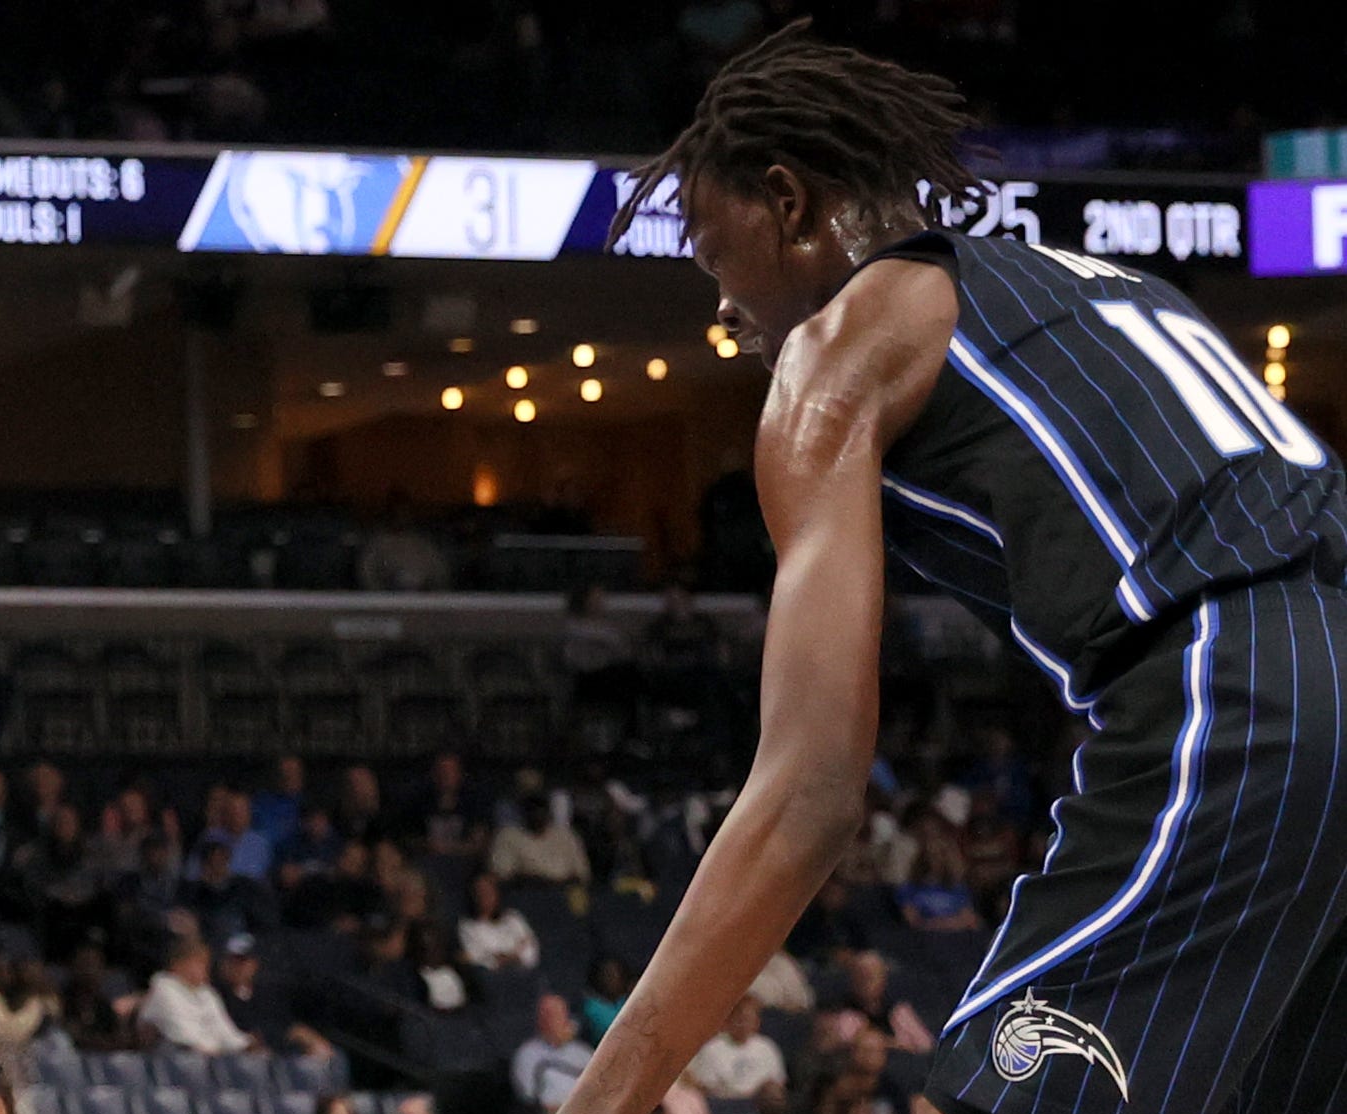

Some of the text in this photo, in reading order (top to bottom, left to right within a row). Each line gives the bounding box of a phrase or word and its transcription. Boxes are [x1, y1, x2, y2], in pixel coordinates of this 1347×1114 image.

[462, 165, 519, 253] 31
[1083, 199, 1241, 260] 2ND QTR
[1091, 299, 1328, 469] 10
